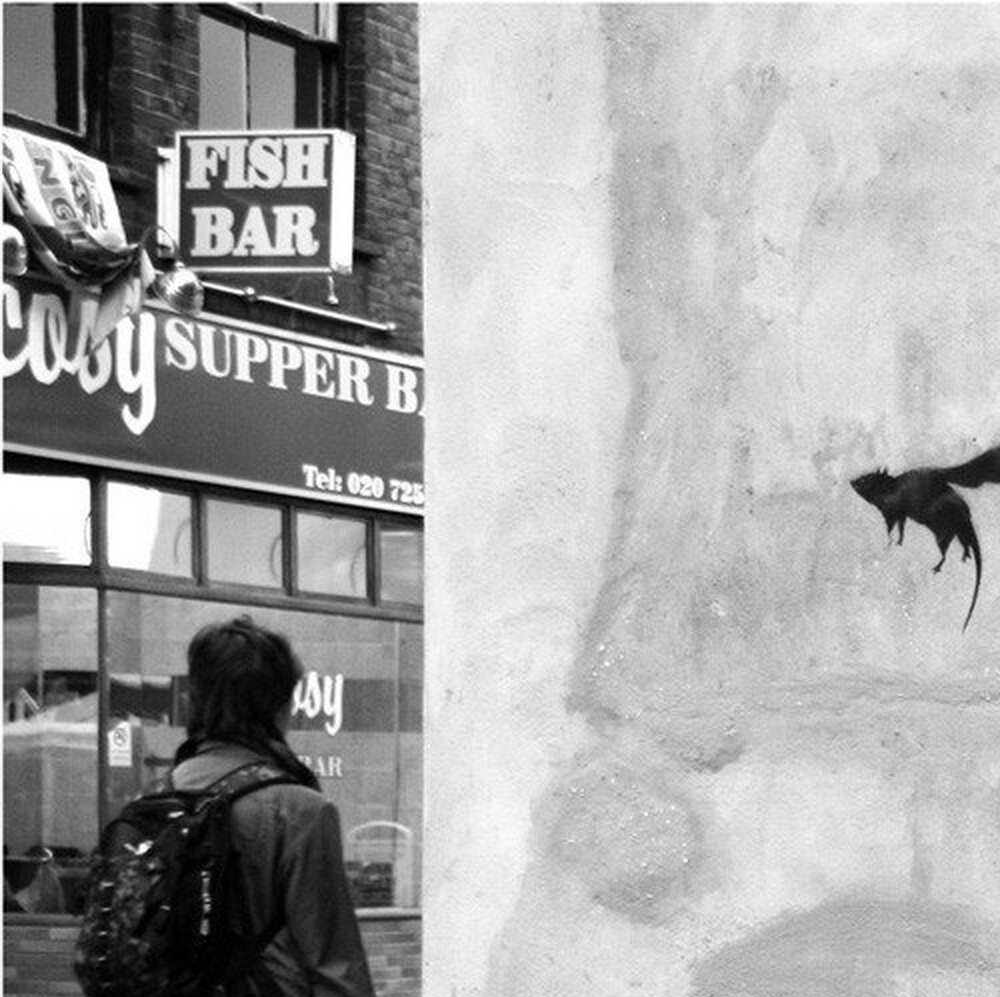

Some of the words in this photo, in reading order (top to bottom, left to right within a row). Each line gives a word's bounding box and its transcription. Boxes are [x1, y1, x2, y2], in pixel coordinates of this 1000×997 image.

[184, 136, 329, 190] FISH
[189, 205, 320, 258] BAR
[164, 317, 375, 407] SUPPER
[385, 364, 424, 417] B
[301, 463, 343, 494] Tel:
[347, 471, 385, 499] 020
